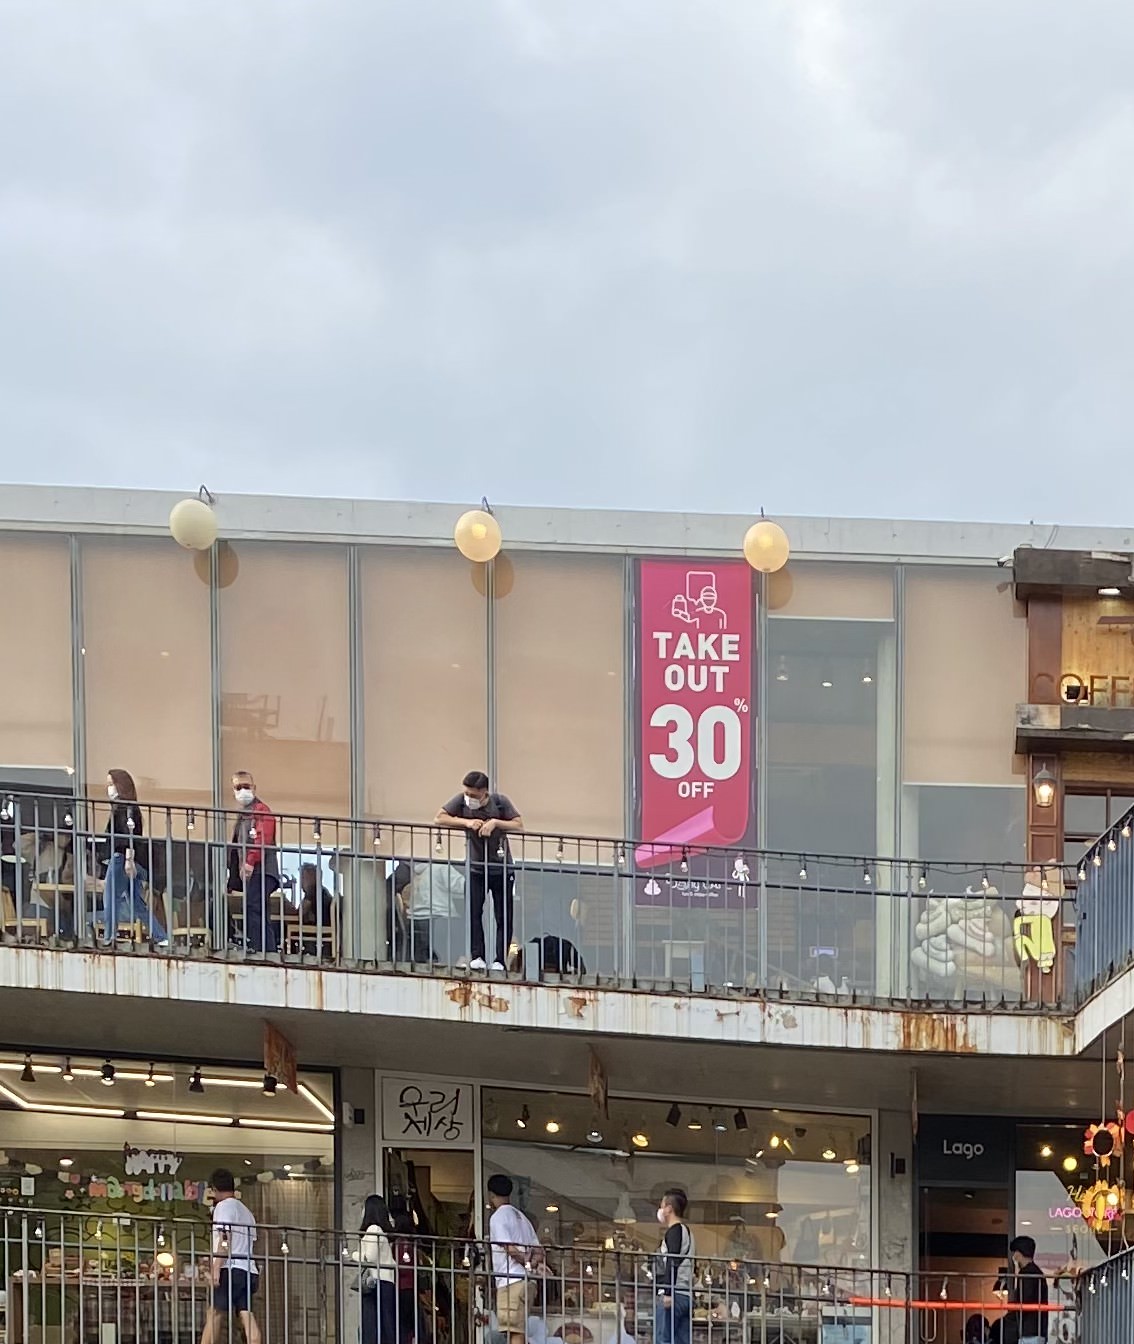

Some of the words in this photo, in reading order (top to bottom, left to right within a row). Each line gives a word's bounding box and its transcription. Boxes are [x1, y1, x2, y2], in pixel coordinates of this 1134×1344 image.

[652, 631, 740, 661] TAKE
[664, 664, 730, 693] OUT
[677, 781, 715, 798] OFF
[399, 1085, 461, 1117] 우리
[402, 1112, 464, 1141] 세상
[943, 1139, 985, 1160] Lago
